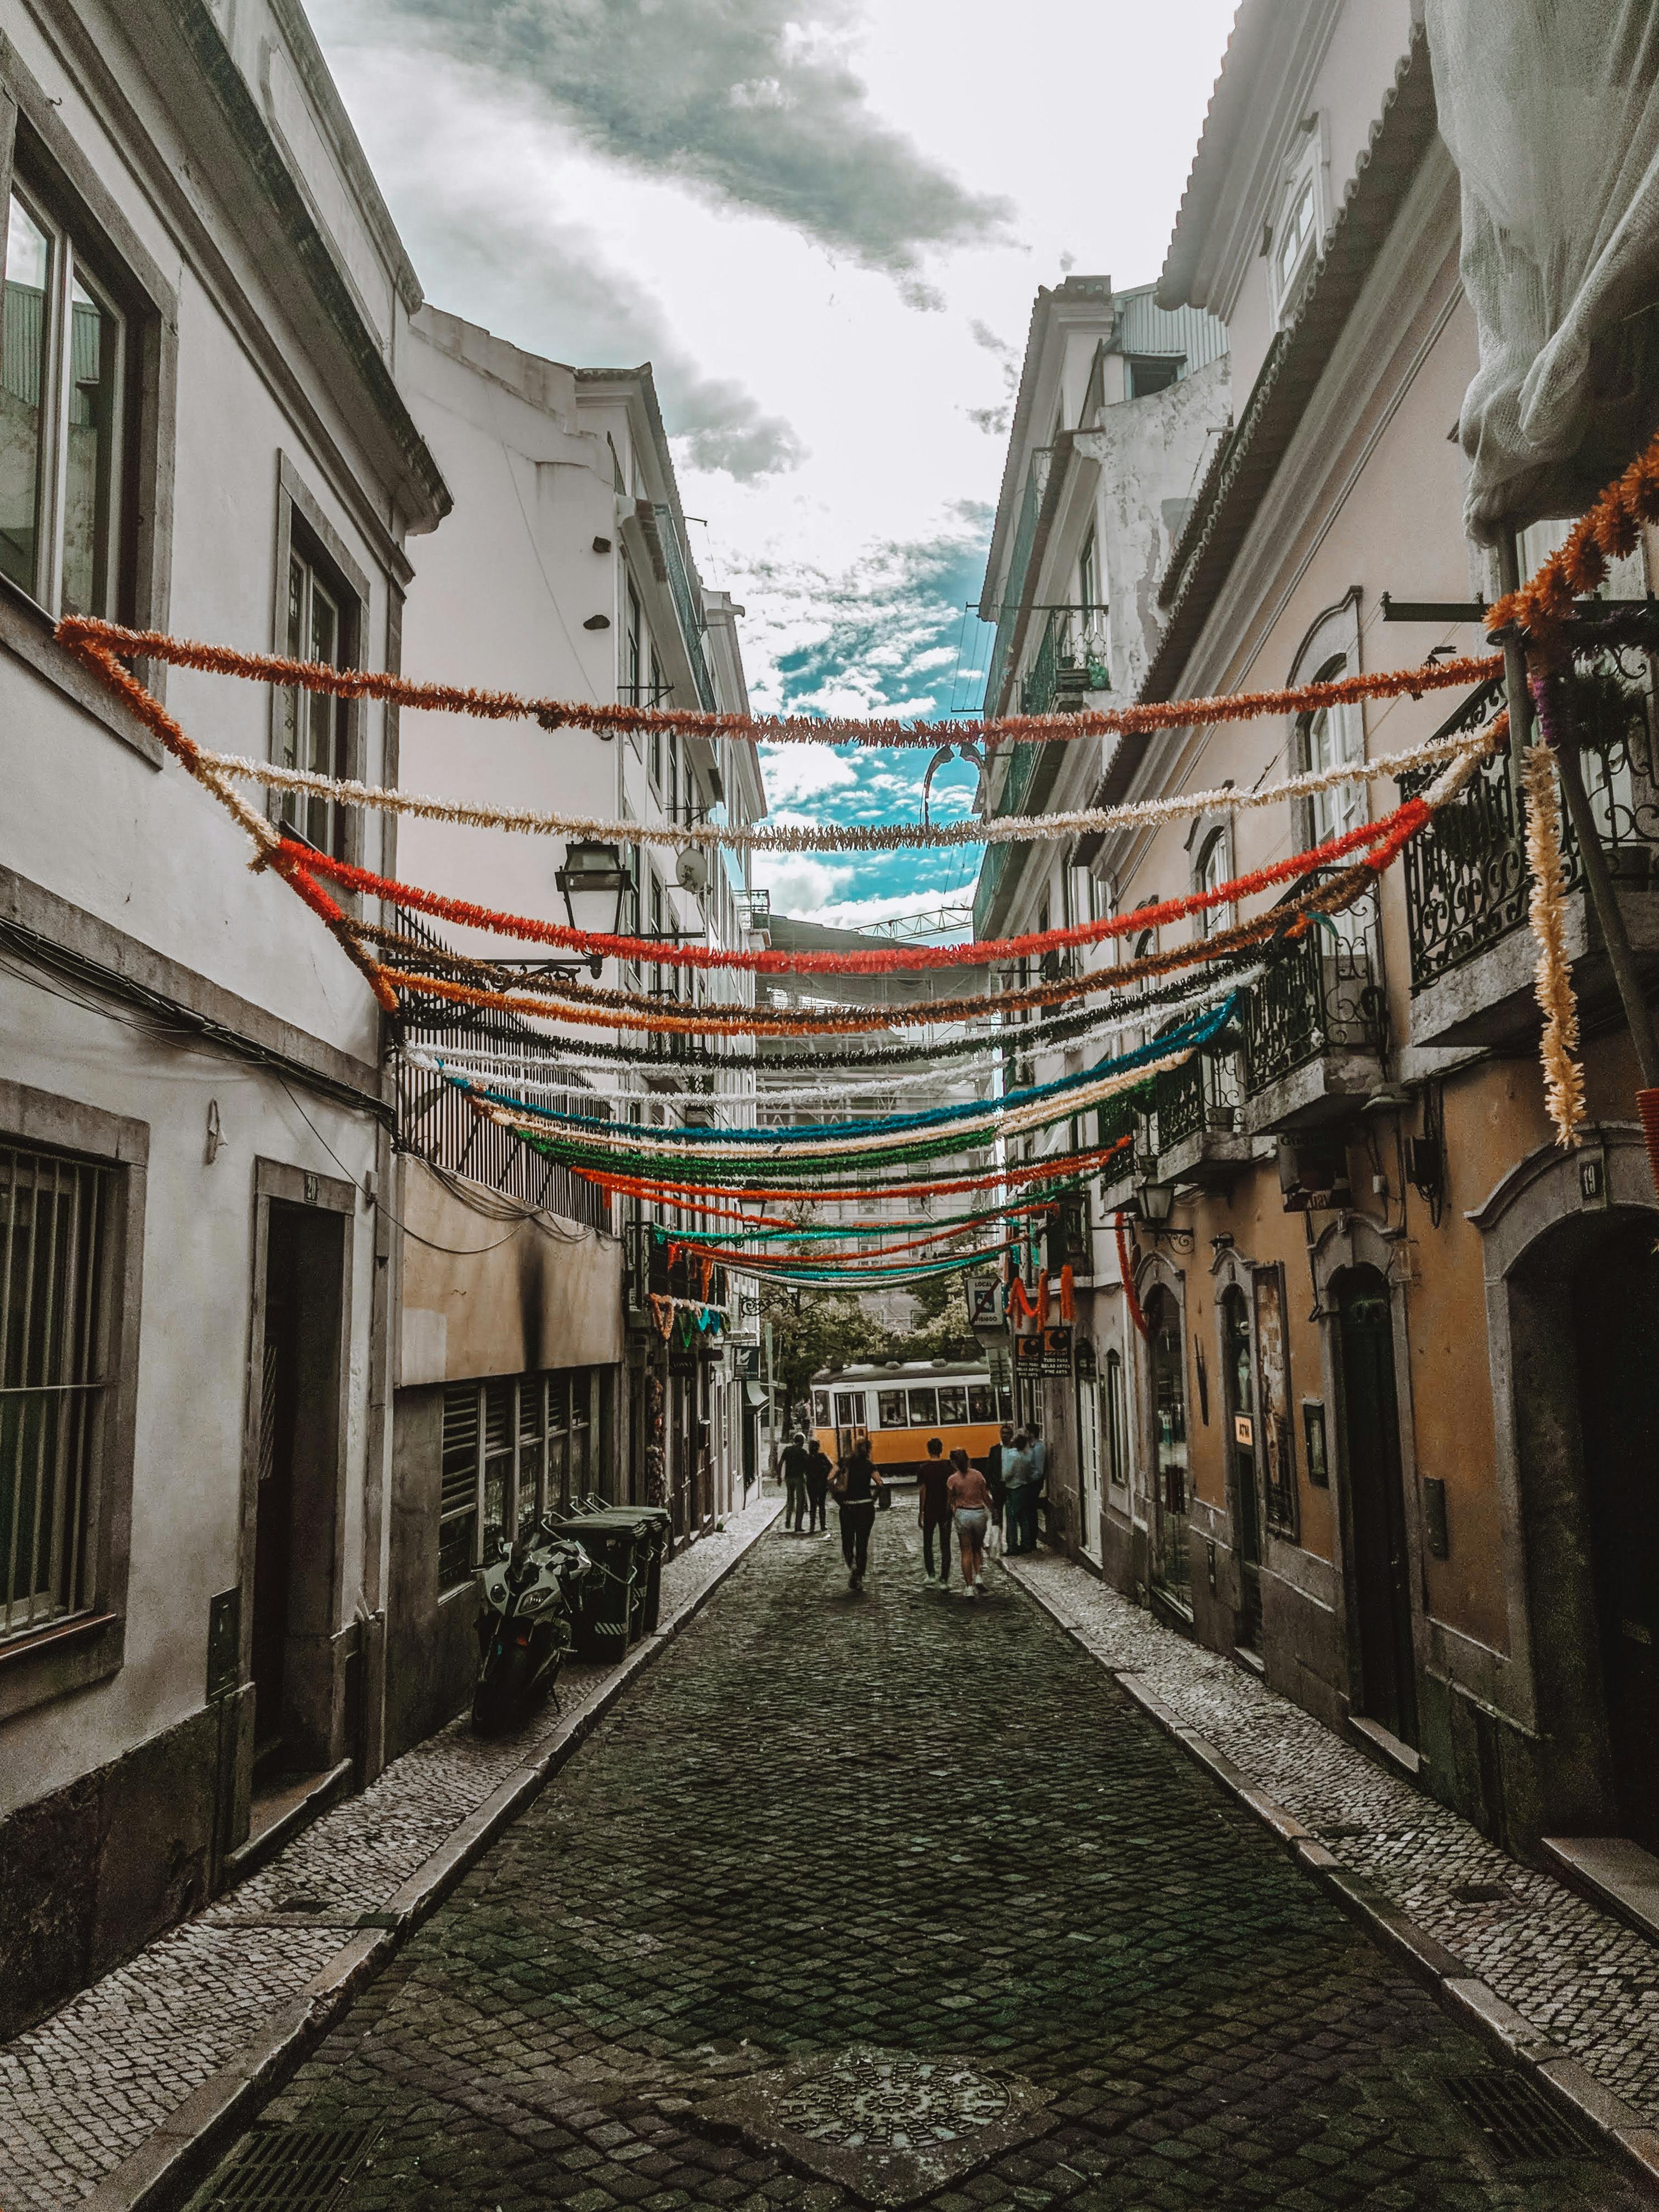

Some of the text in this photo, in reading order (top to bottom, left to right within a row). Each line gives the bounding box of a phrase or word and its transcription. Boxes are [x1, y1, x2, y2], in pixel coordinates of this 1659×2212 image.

[307, 1176, 316, 1199] 20
[1583, 1165, 1596, 1194] 19
[1239, 1424, 1250, 1438] ATM
